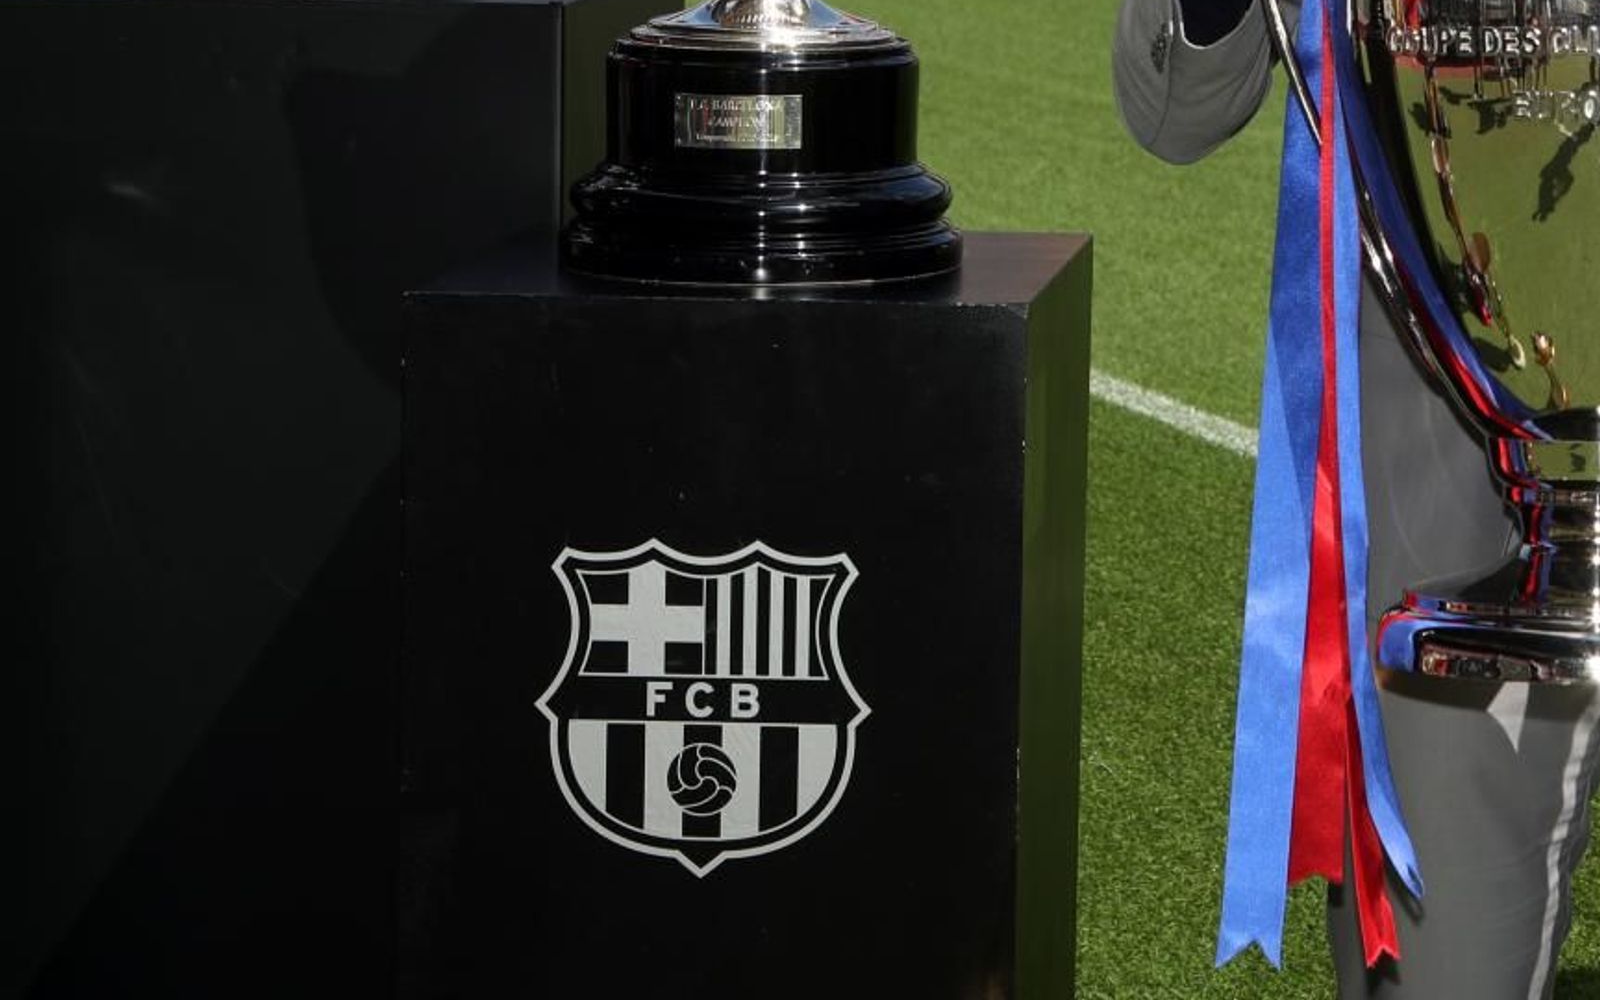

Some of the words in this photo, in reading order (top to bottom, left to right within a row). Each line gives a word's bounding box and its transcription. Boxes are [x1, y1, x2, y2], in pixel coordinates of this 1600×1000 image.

[1386, 25, 1473, 54] COUPE
[1482, 25, 1541, 55] DES
[645, 681, 761, 719] FCB
